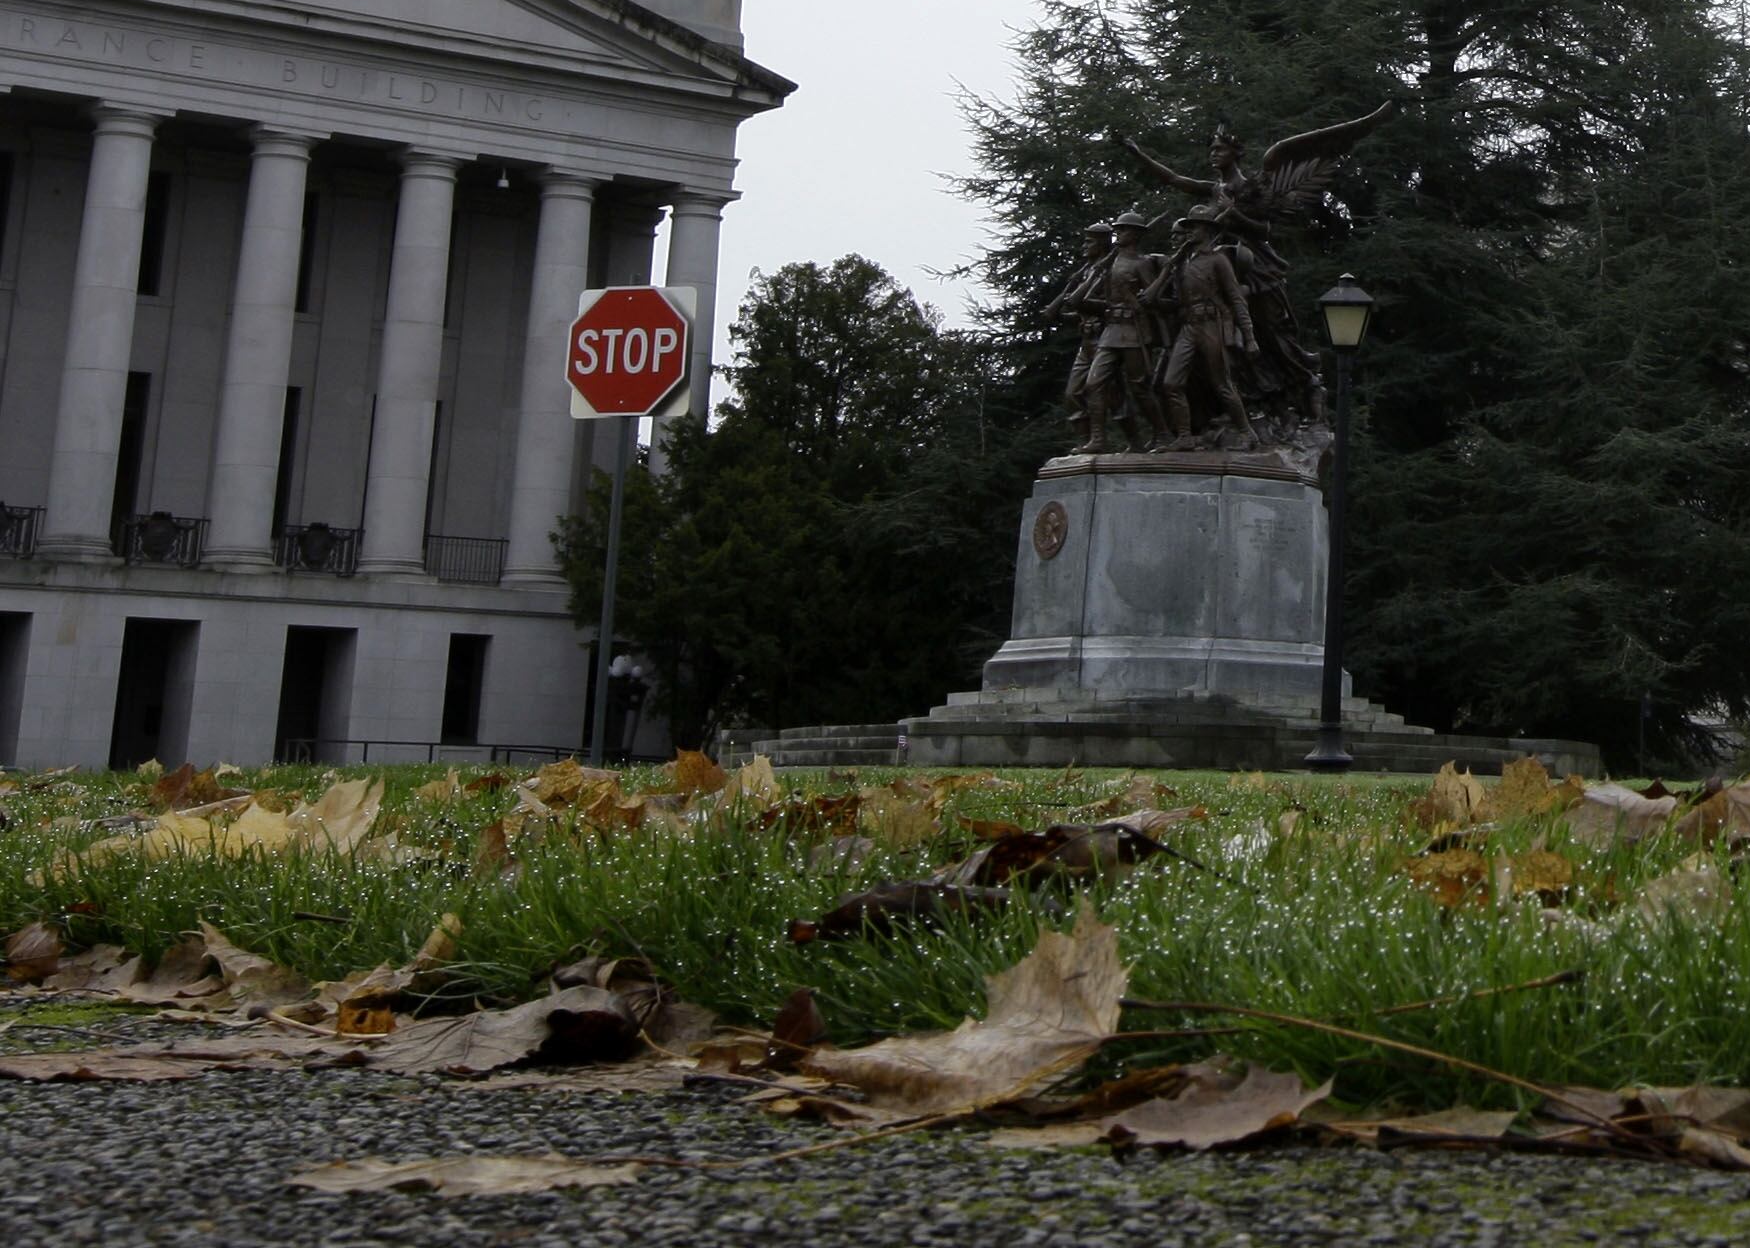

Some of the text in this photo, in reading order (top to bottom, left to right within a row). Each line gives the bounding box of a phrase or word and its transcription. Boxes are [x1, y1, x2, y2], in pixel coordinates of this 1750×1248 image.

[19, 17, 544, 122] RANCE BUILDING
[575, 327, 678, 375] STOP
